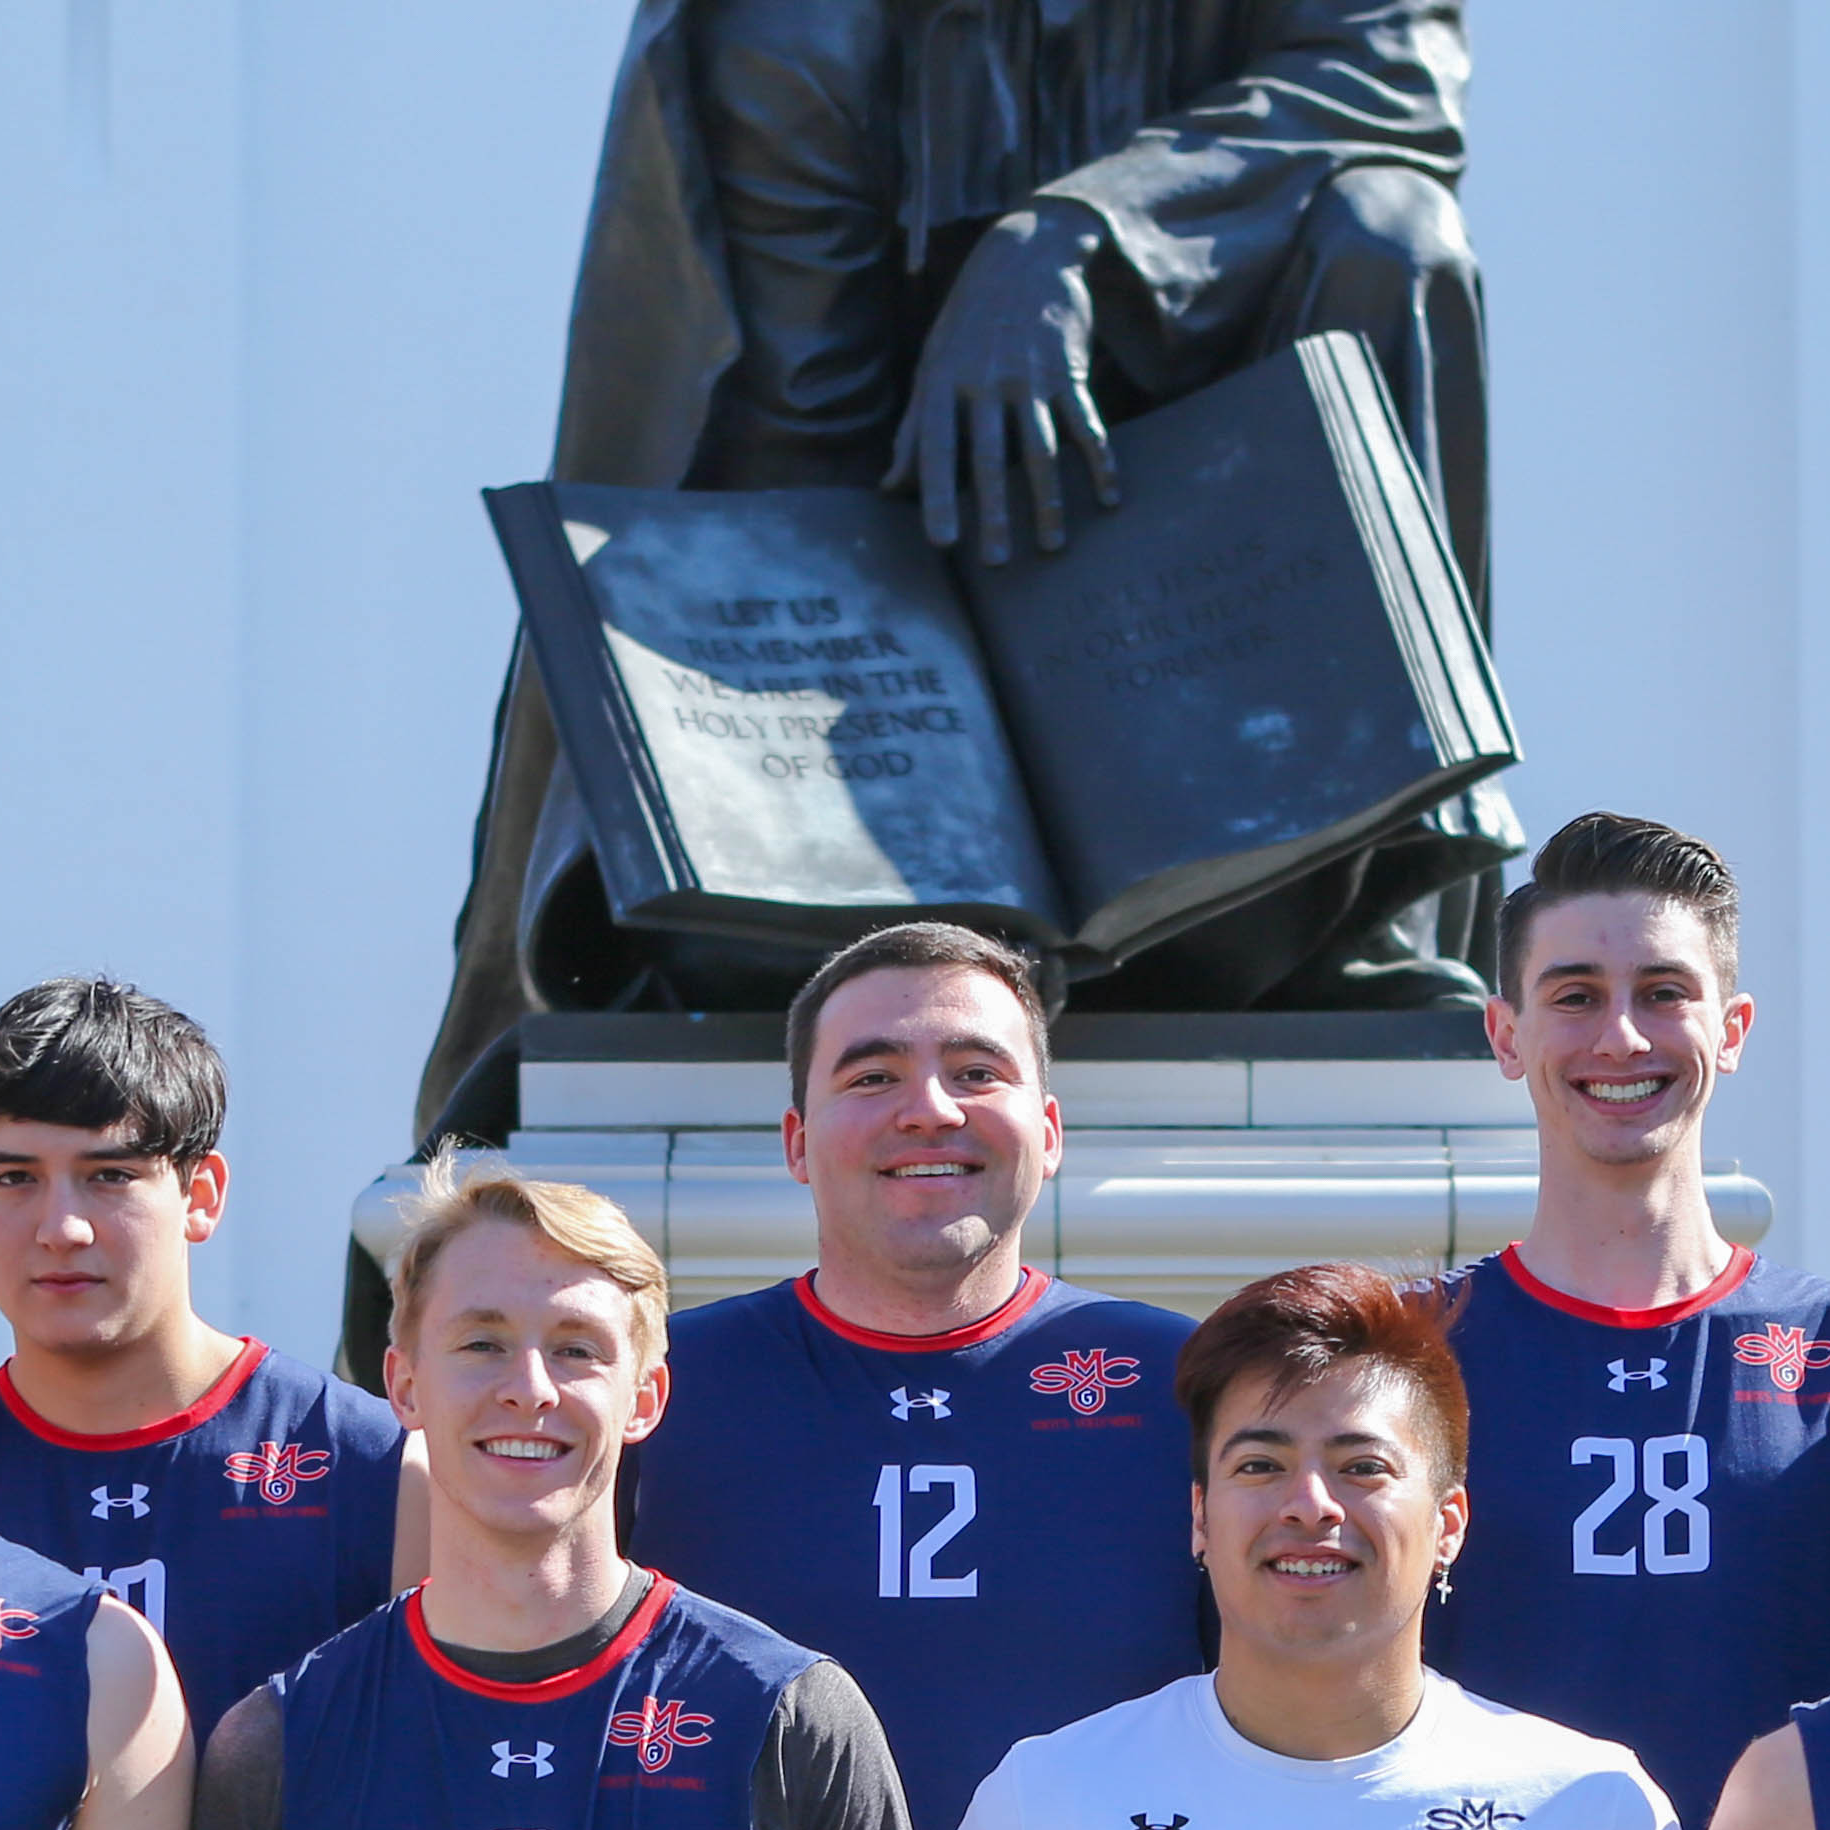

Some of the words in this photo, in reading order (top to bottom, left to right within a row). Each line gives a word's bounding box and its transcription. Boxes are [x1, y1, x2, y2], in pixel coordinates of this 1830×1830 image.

[714, 597, 778, 628] LET
[786, 597, 841, 627] US
[687, 631, 909, 665] REMEMBER
[661, 668, 733, 701] WE
[741, 676, 814, 702] ARE
[818, 674, 864, 698] IN
[867, 666, 947, 697] THE
[673, 705, 768, 740] HOLY
[777, 705, 969, 742] PRESENCE
[761, 751, 811, 780] OF
[824, 750, 917, 780] GOD
[1573, 1435, 1711, 1575] 28
[873, 1464, 978, 1598] 12
